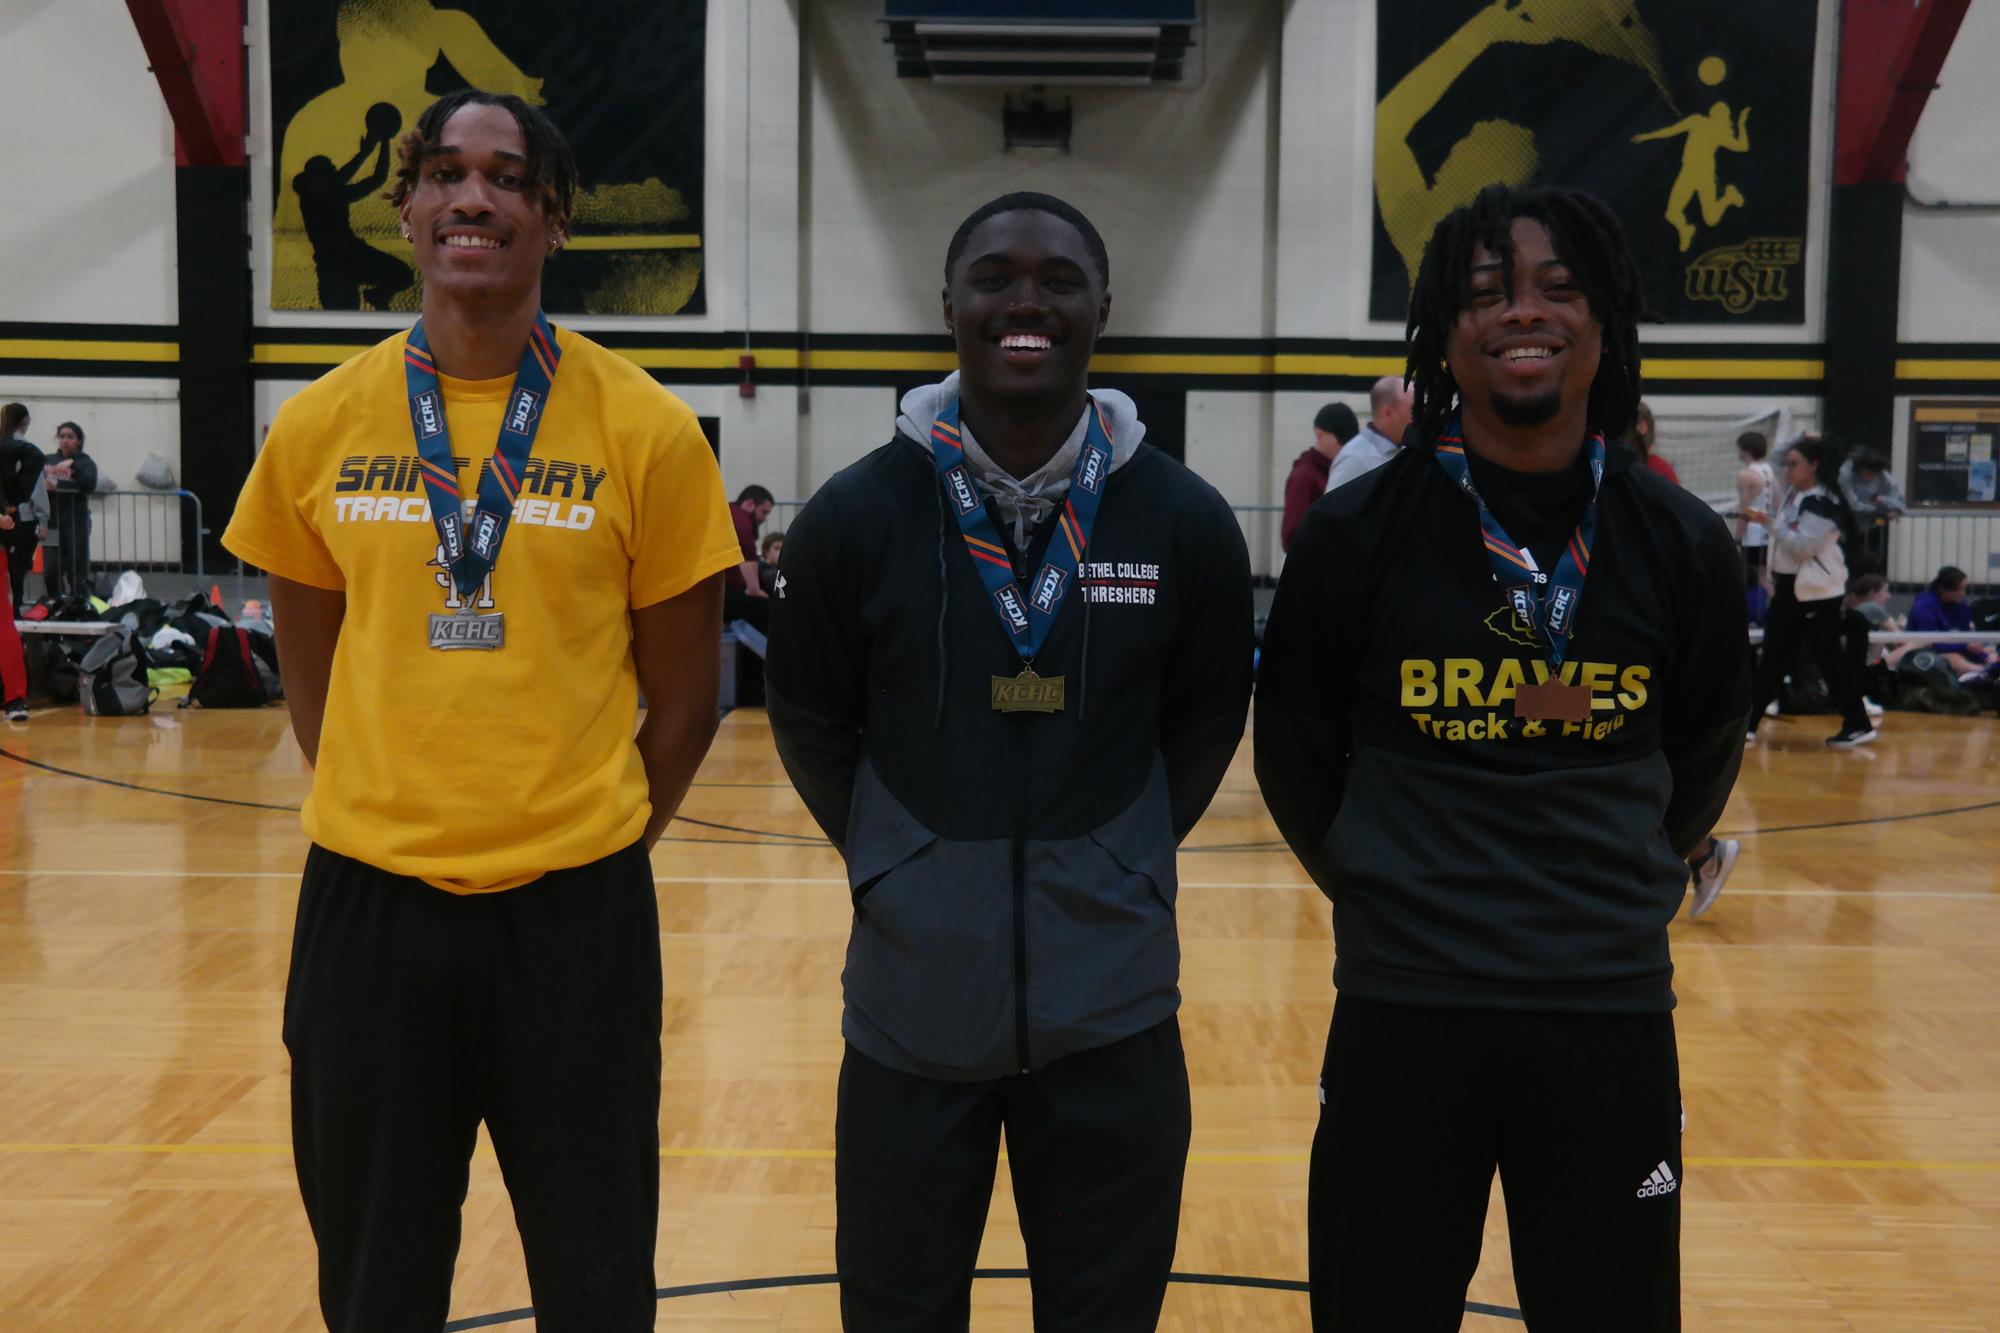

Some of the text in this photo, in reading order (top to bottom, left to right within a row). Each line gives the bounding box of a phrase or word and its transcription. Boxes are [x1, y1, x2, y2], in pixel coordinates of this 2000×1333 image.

[419, 395, 437, 433] KCAC
[512, 392, 533, 431] KCAC
[1083, 449, 1102, 489] KCAC
[951, 470, 974, 508] KCAC
[444, 517, 460, 558] KCAC
[475, 514, 497, 555] KCAC
[1037, 568, 1061, 609] KCAC
[1078, 562, 1160, 580] BETHEL COLLEGE
[1000, 589, 1029, 627] KCAC
[1080, 585, 1156, 605] THRESHERS
[1549, 589, 1571, 630] KCAC
[432, 621, 500, 640] KCAC
[993, 682, 1062, 704] KCAC
[1400, 658, 1651, 711] BRAVES
[1410, 712, 1508, 741] Track
[1636, 1180, 1676, 1198] adidas
